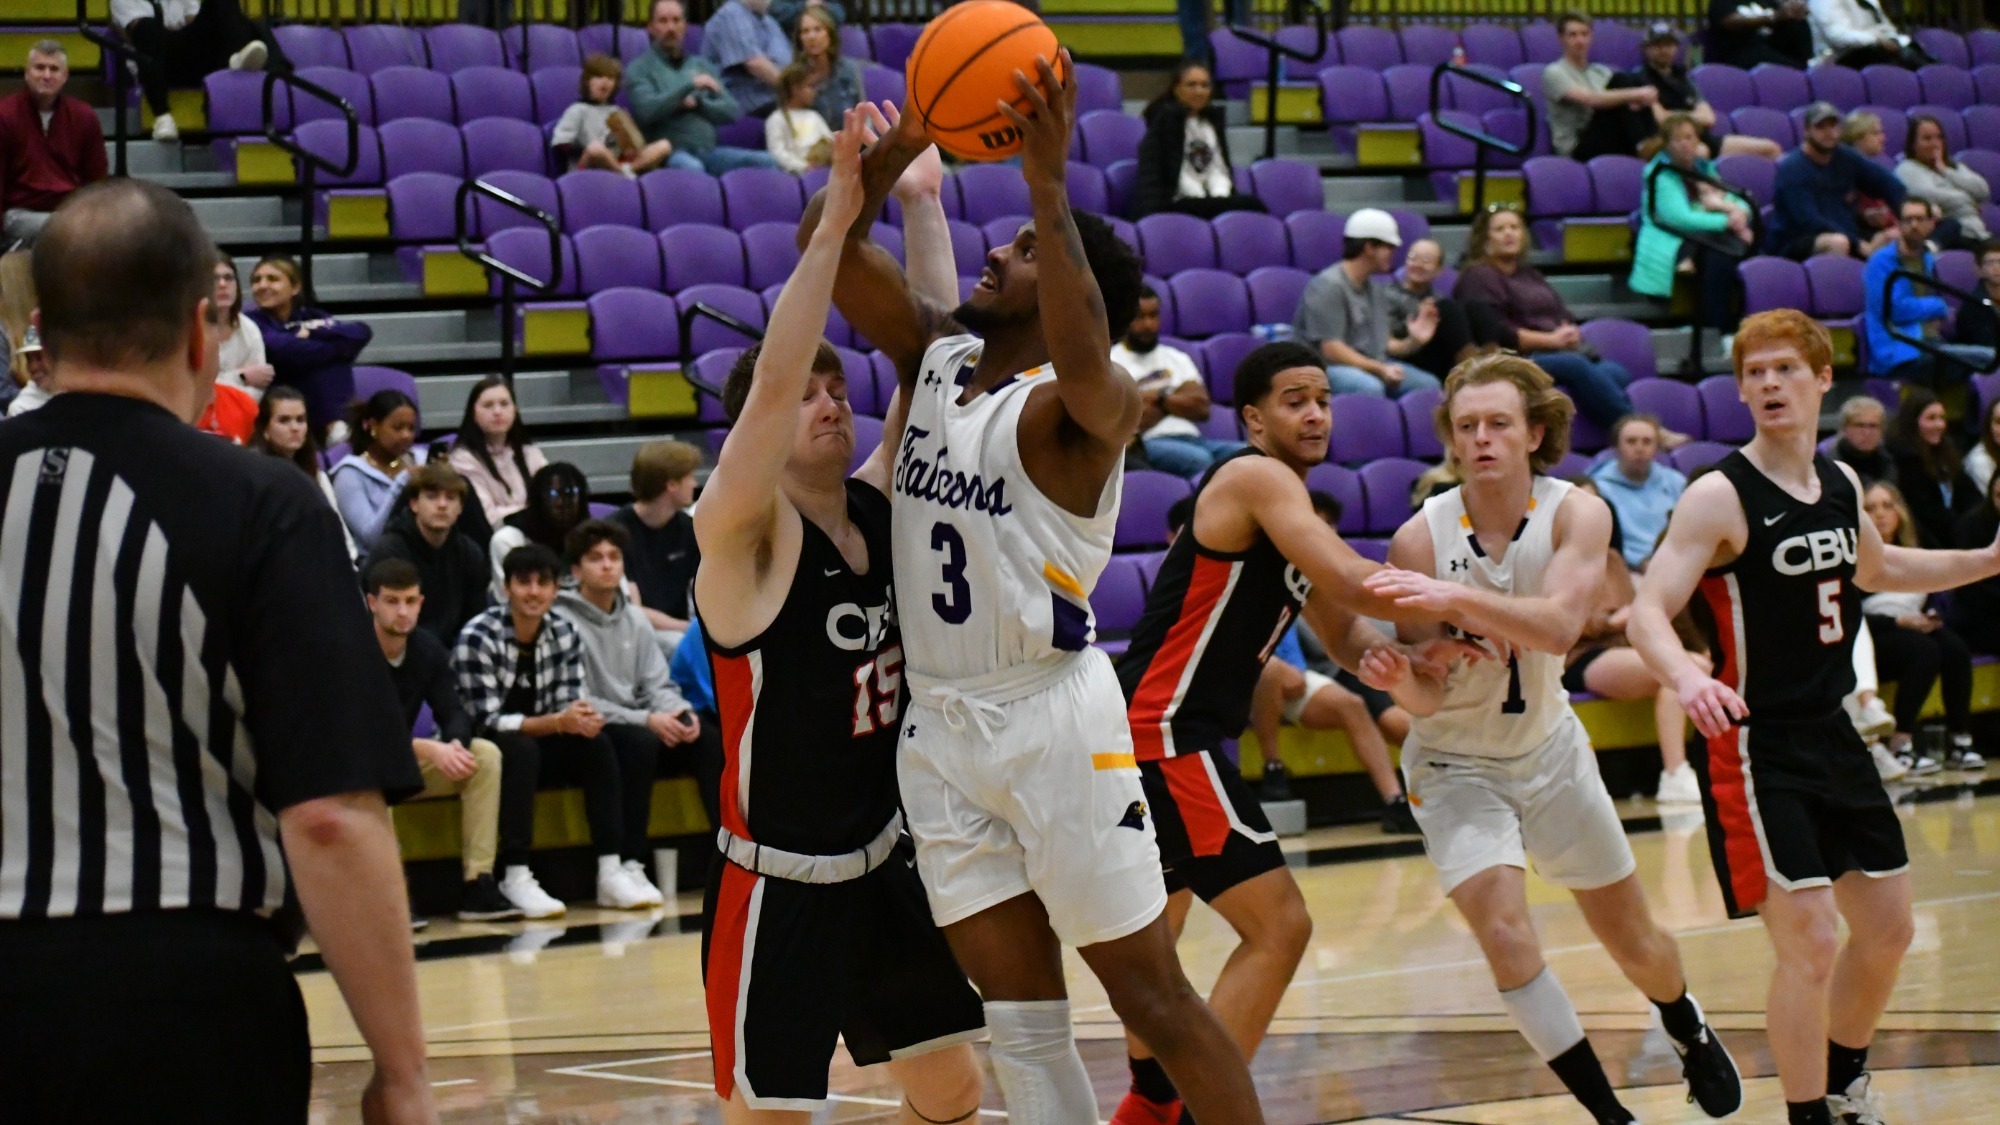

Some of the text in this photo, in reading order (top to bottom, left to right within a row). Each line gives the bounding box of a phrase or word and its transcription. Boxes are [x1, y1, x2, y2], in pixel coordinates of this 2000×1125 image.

[896, 425, 1012, 516] Falcons
[931, 521, 972, 625] 3
[1772, 527, 1858, 576] CBU
[1817, 577, 1844, 645] 5
[852, 641, 903, 738] 15
[1501, 646, 1526, 714] 1
